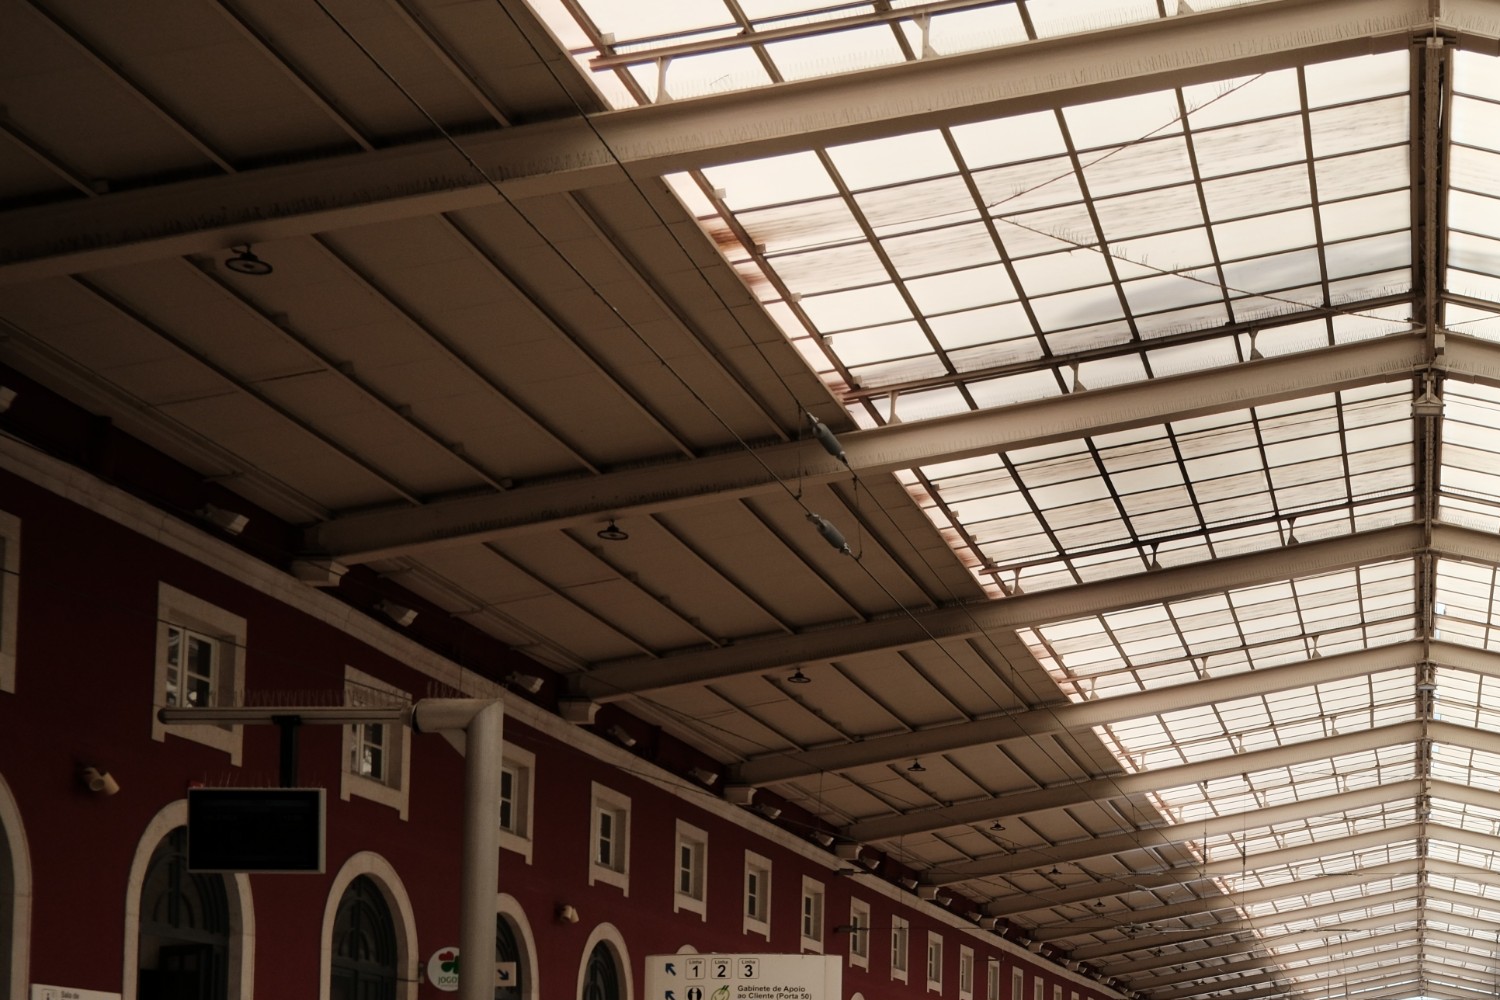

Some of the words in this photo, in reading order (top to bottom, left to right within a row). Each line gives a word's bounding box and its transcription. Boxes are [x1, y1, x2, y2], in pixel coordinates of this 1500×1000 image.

[692, 966, 698, 977] 1
[718, 965, 726, 977] 2
[744, 965, 753, 977] 3
